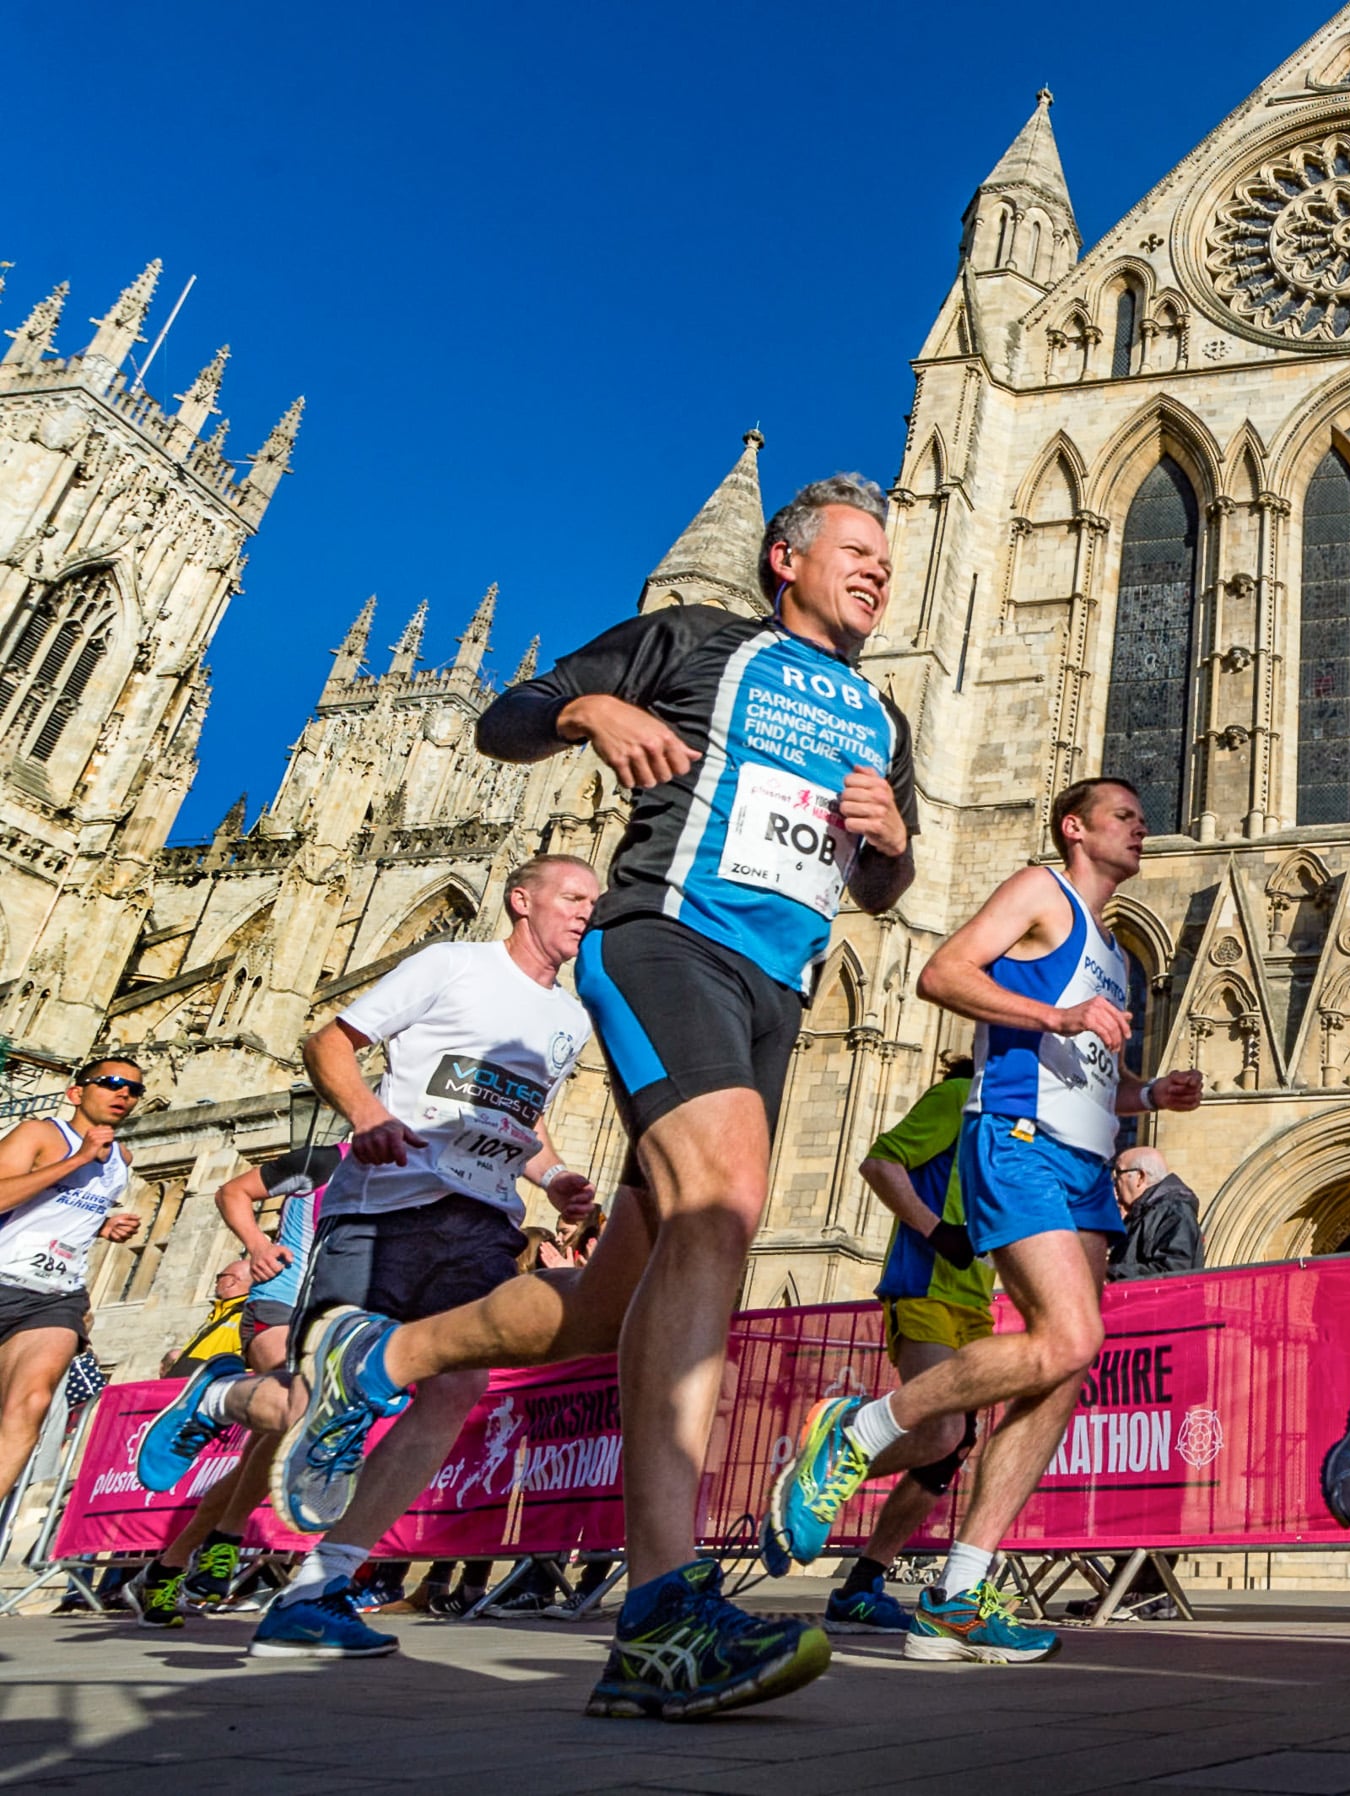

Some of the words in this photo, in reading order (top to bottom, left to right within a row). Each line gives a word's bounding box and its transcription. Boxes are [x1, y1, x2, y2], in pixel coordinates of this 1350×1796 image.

[782, 665, 863, 709] ROB
[746, 704, 816, 735] CHANGE
[748, 688, 867, 741] PARKINSON'S
[743, 735, 782, 756] JOIN
[783, 745, 807, 767] US.
[744, 719, 785, 741] FIND
[786, 731, 797, 746] A
[799, 736, 841, 763] CURE.
[764, 812, 836, 866] ROB
[731, 863, 768, 879] ZONE
[795, 862, 803, 871] 6
[445, 1079, 521, 1112] MOTORS
[468, 1133, 523, 1165] 1079
[30, 1253, 67, 1275] 284
[1043, 1410, 1172, 1476] RATHON
[89, 1467, 145, 1504] plusne
